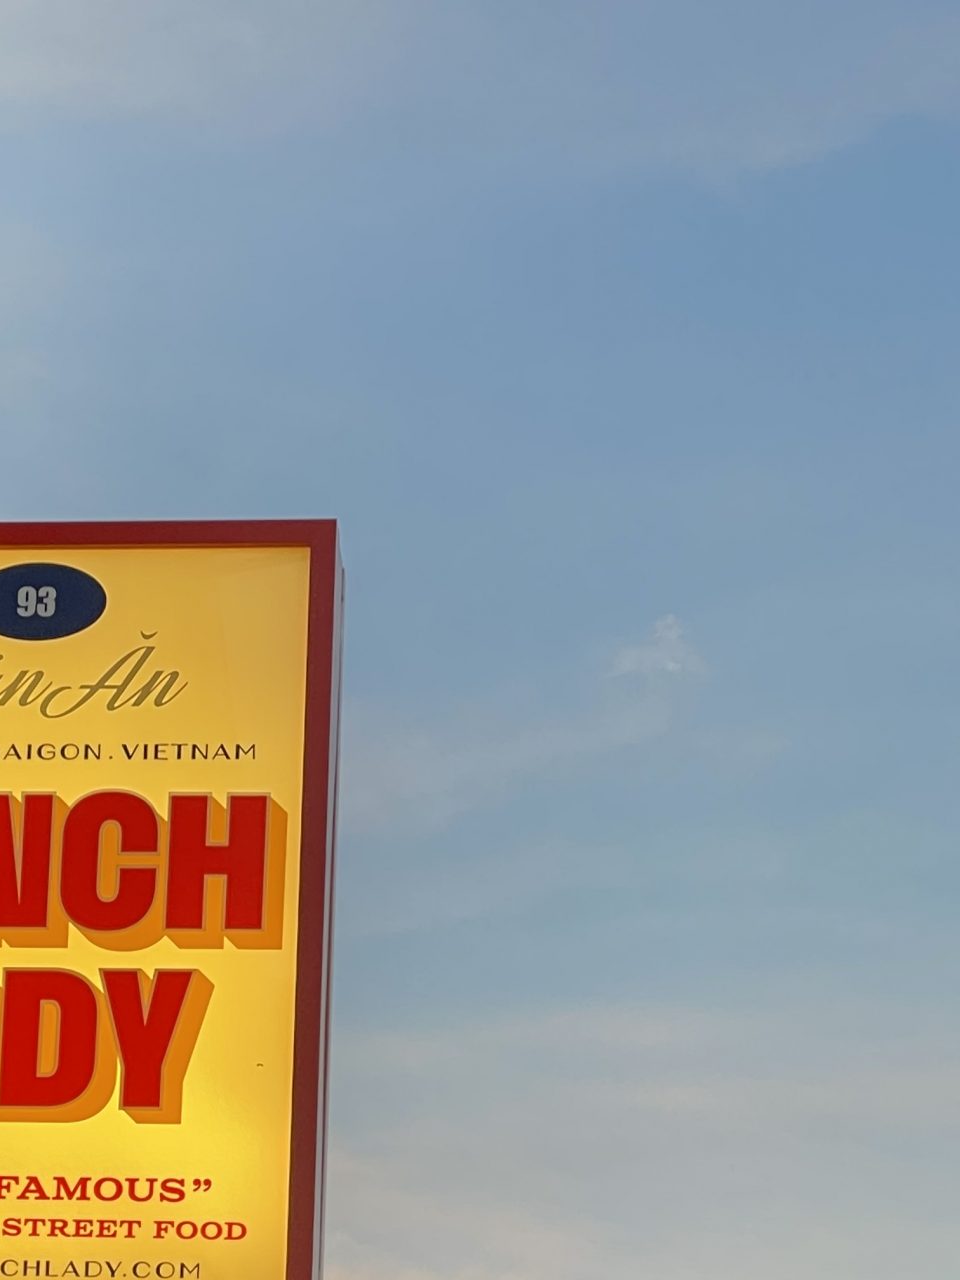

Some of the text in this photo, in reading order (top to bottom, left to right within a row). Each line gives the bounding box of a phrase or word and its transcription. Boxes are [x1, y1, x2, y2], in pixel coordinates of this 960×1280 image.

[16, 586, 57, 618] 93
[40, 631, 189, 719] Ăn
[2, 1217, 142, 1239] STREET
[153, 1220, 248, 1241] FOOD
